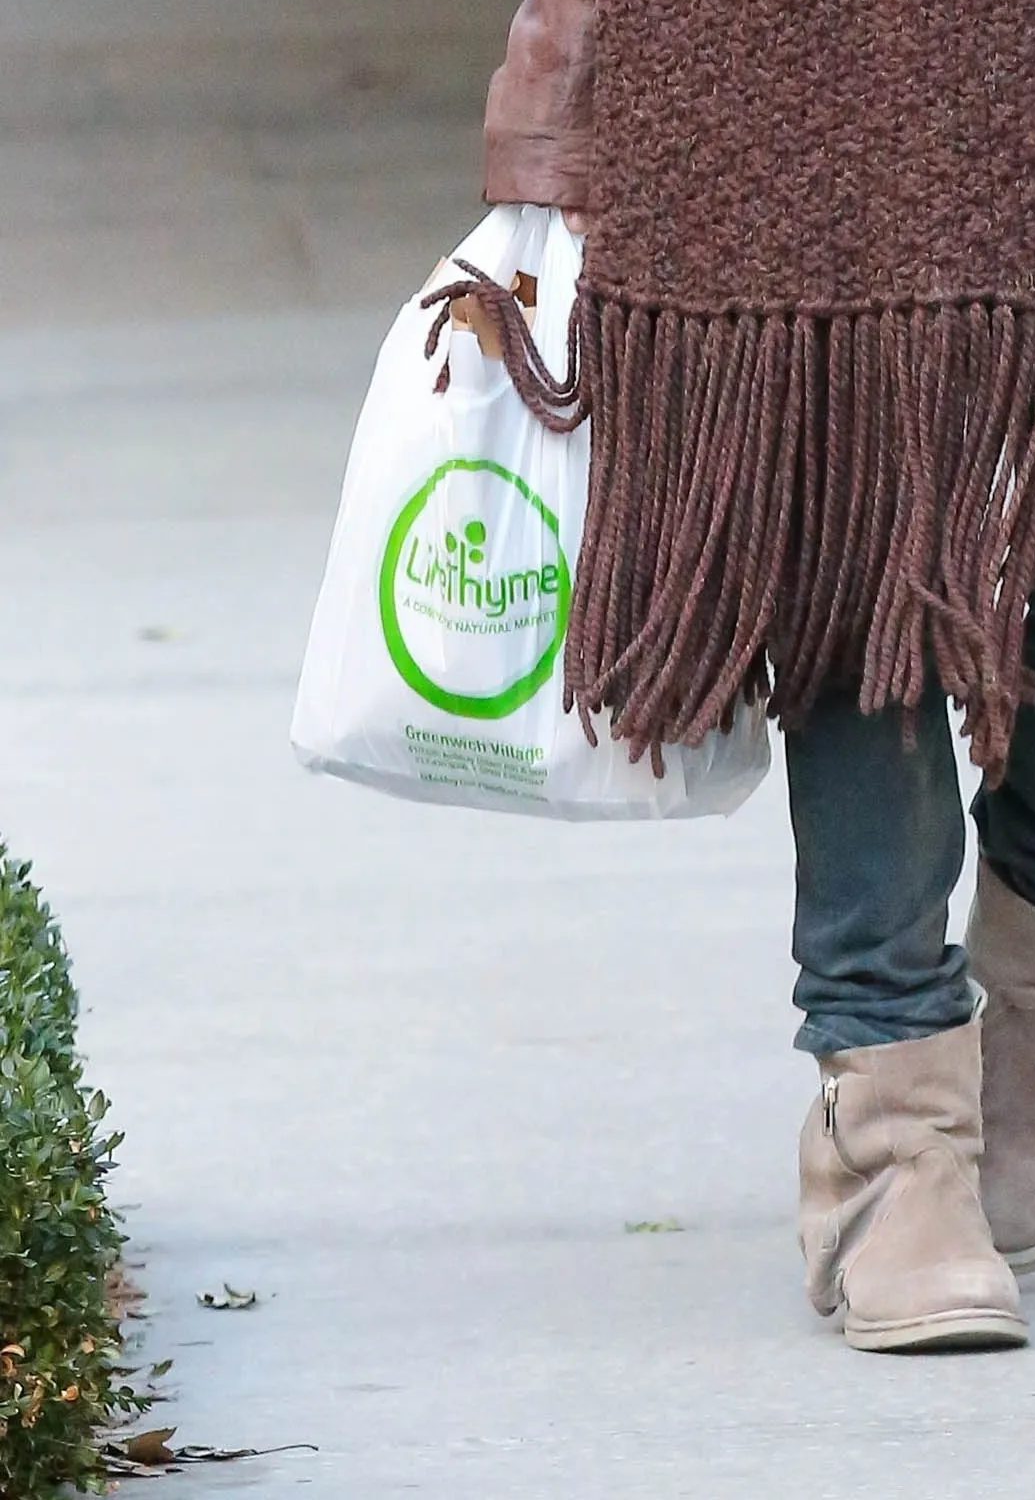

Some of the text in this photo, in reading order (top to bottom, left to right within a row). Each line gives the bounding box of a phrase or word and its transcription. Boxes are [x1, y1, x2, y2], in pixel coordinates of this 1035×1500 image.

[455, 619, 511, 635] NATURAL
[405, 724, 486, 753] Greenwich
[491, 739, 544, 765] Village
